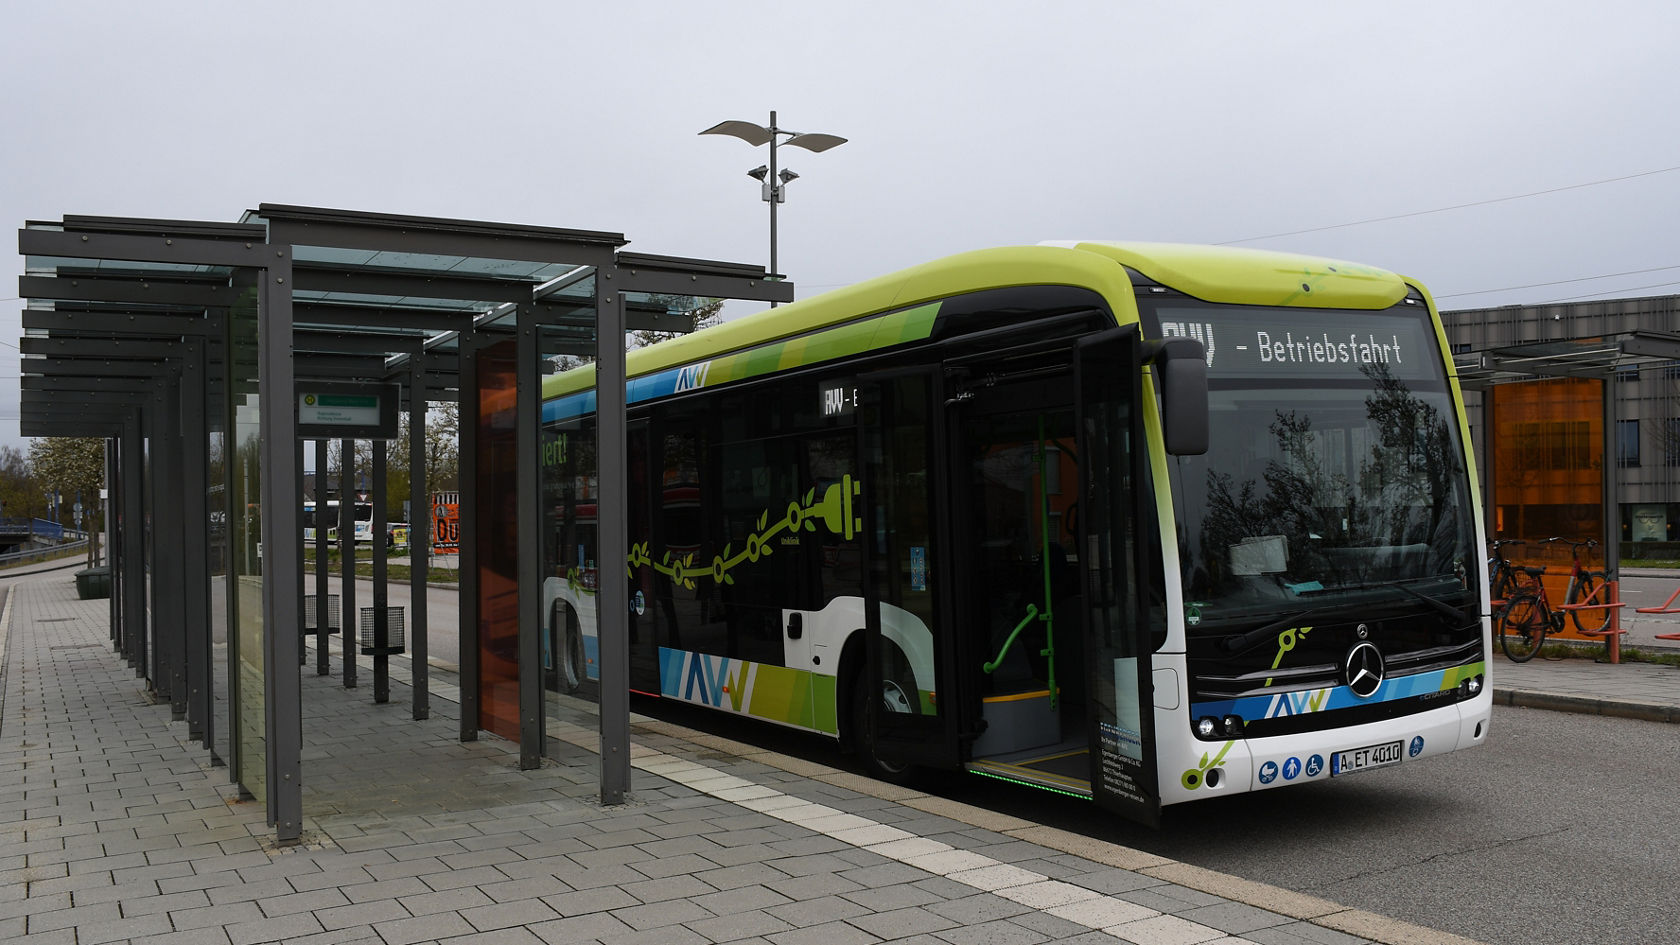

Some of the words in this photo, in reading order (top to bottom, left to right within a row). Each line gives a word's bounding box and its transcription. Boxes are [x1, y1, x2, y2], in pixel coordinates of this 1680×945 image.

[1257, 332, 1402, 363] Betriebsfahrt
[825, 388, 843, 415] AVV
[1340, 754, 1348, 770] A
[1355, 750, 1370, 768] ET
[1372, 744, 1400, 765] 4010
